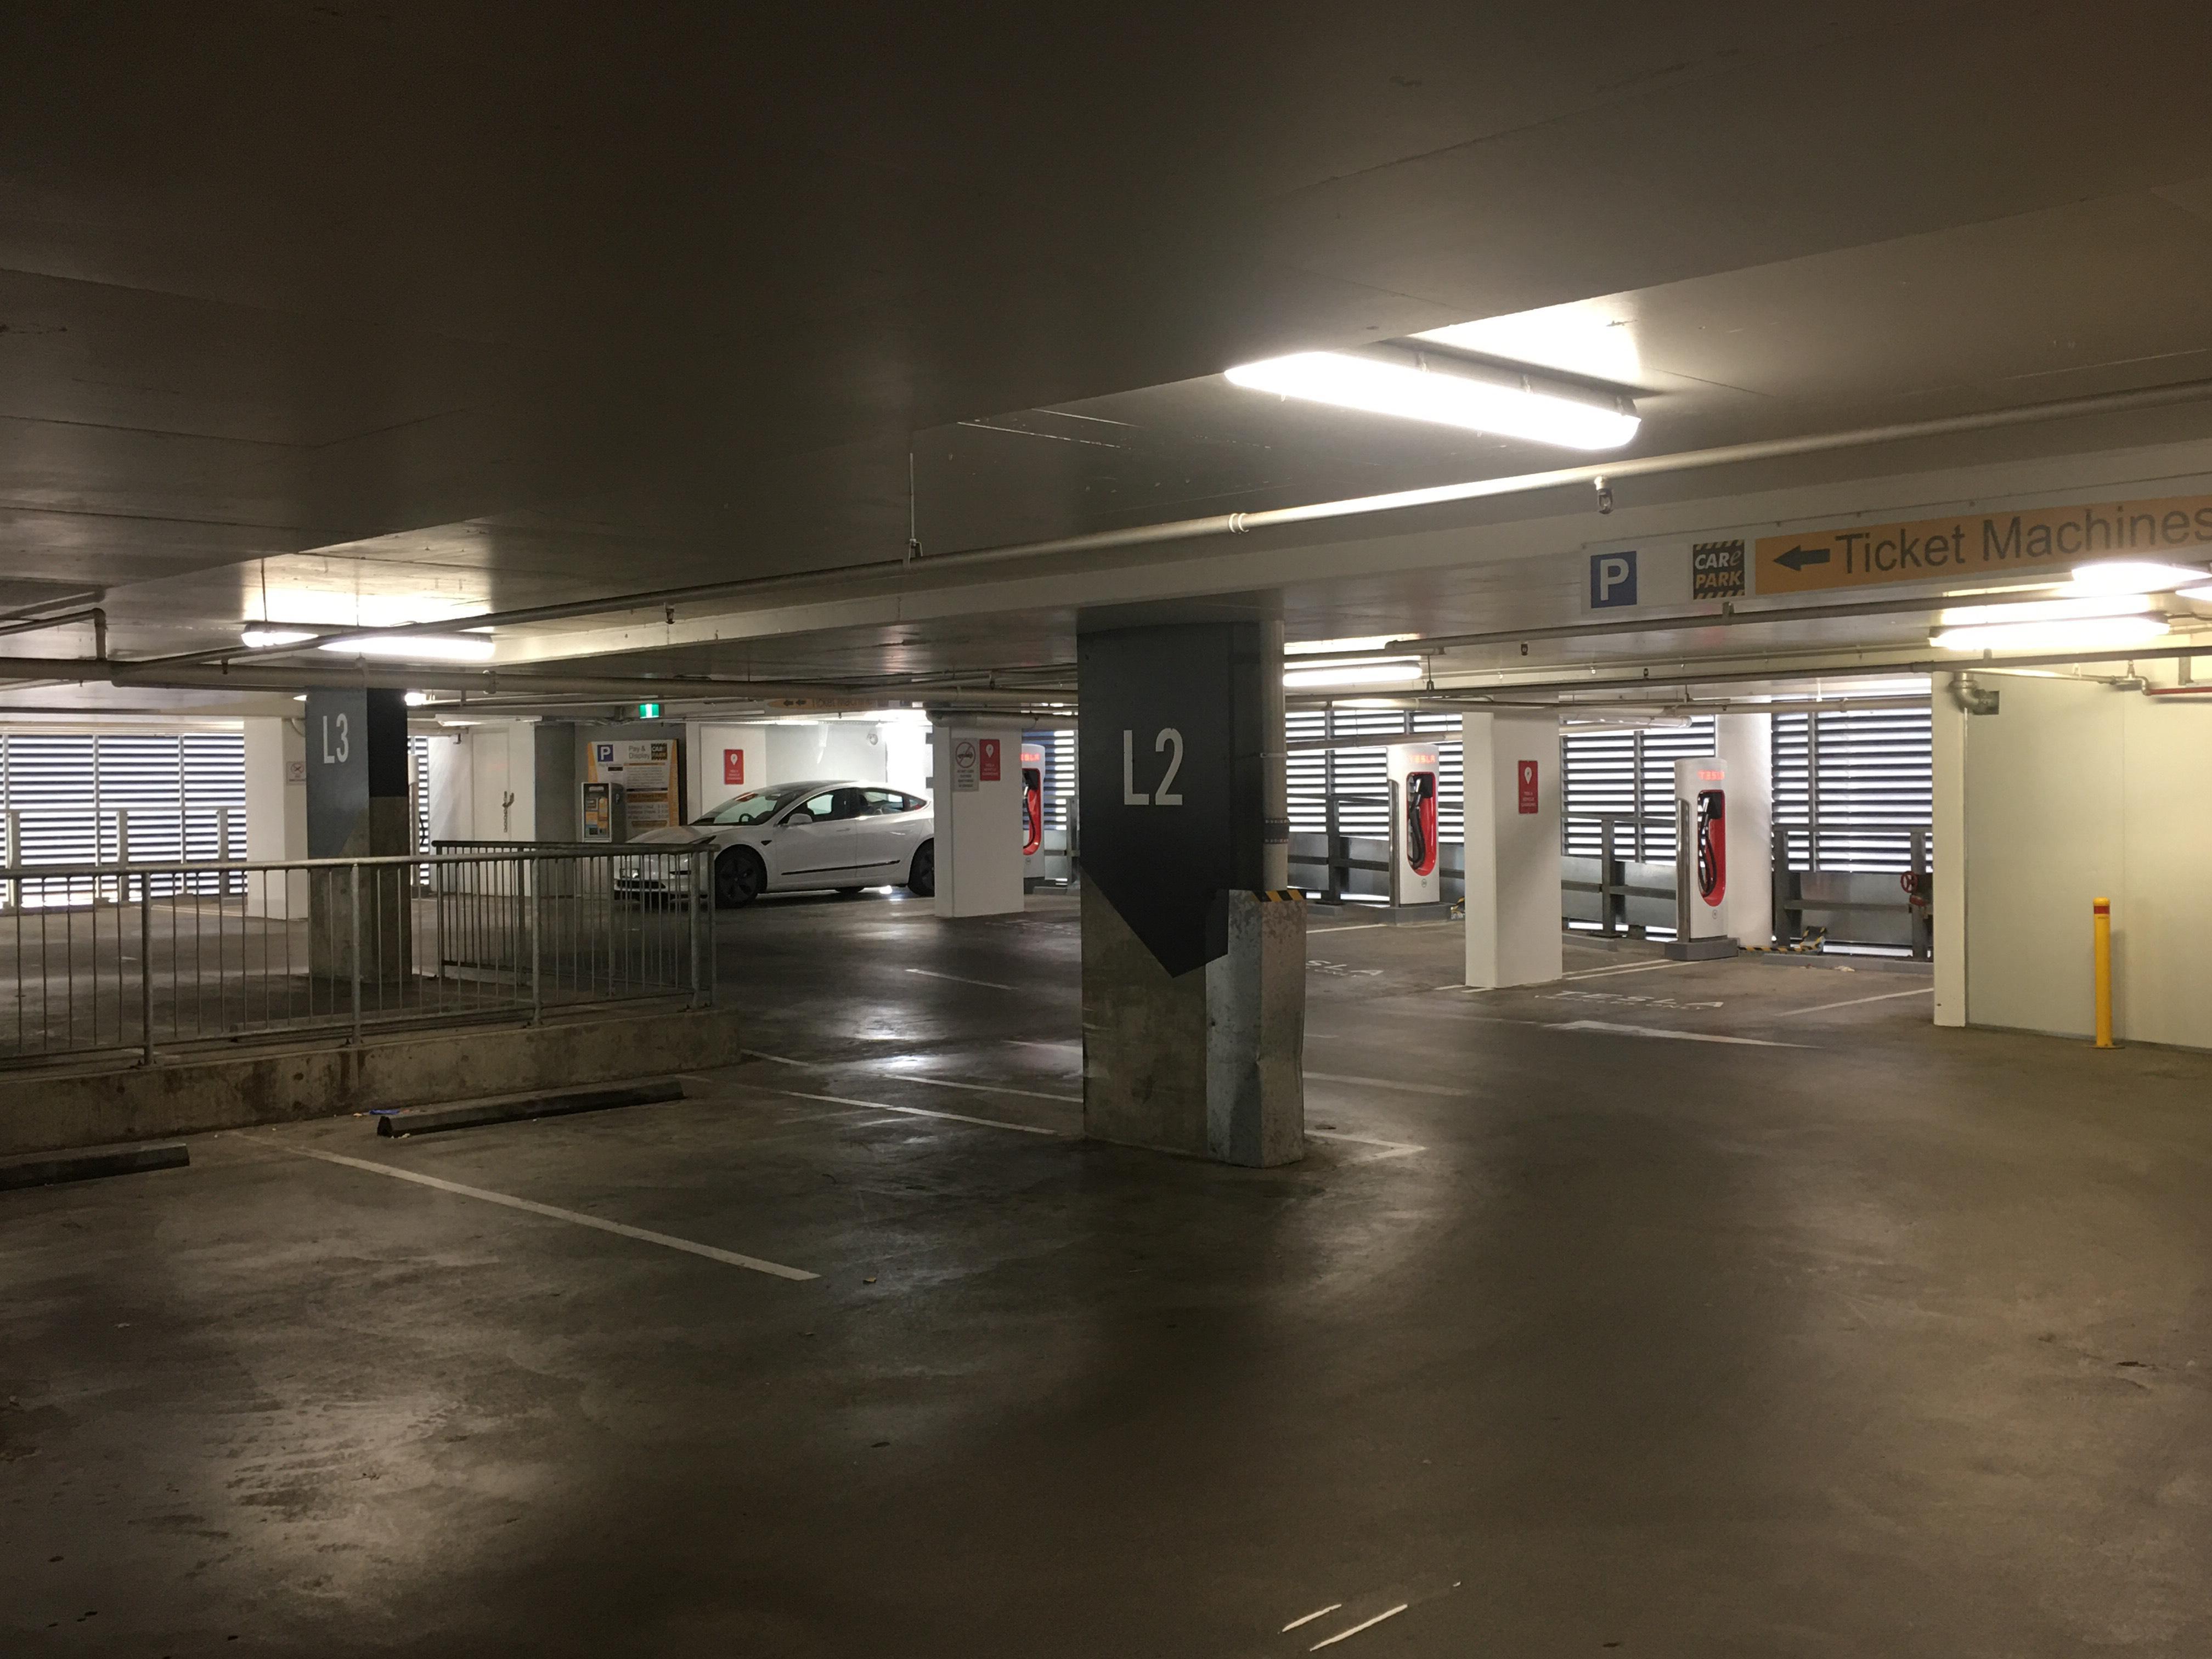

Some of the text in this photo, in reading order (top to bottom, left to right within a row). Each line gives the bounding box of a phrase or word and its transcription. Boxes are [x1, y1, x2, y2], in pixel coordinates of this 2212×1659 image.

[1835, 505, 2212, 574] Ticket Machines
[1600, 558, 1629, 601] P
[1695, 570, 1743, 589] PARK
[323, 713, 349, 764] L3
[601, 747, 611, 760] P
[1124, 727, 1183, 805] L2
[1306, 960, 1384, 975] SLA
[1556, 991, 1724, 1007] TESLA
